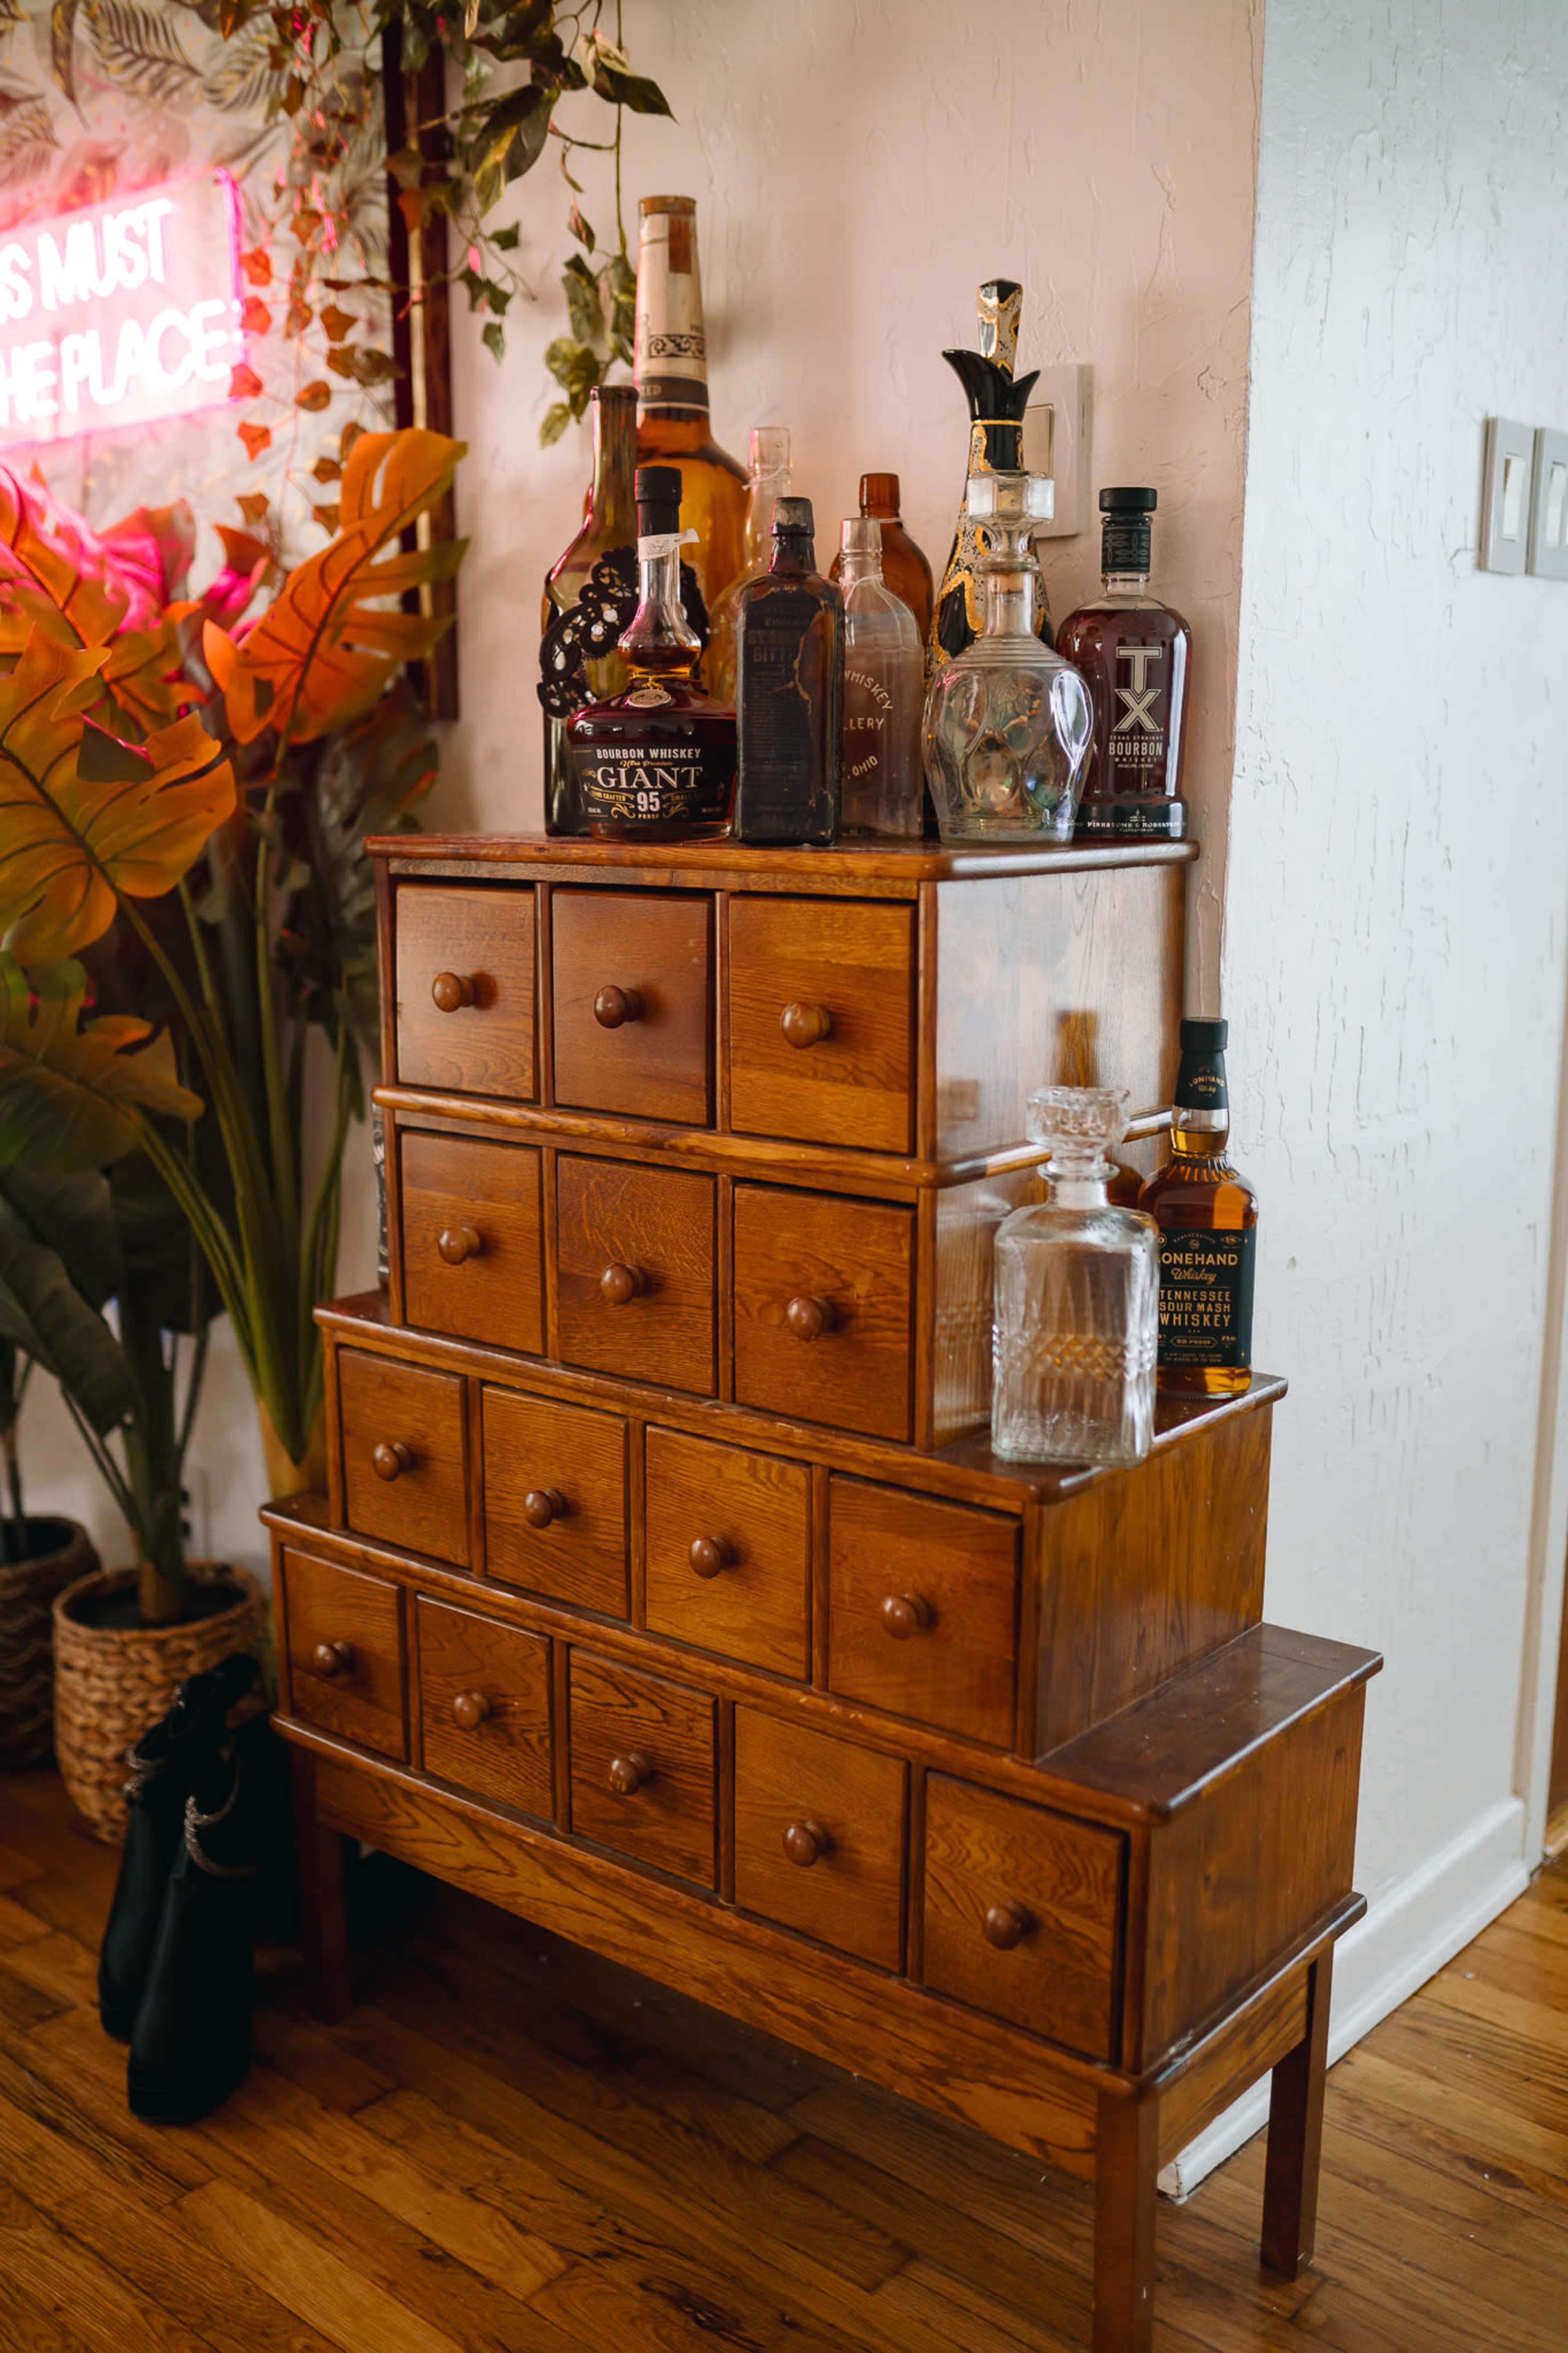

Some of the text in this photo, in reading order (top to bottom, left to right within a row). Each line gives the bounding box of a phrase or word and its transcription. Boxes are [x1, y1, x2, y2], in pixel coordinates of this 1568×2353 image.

[39, 199, 172, 310] MUST
[0, 300, 229, 424] HE PLACE
[1114, 646, 1163, 732] TX
[844, 717, 884, 730] LERY
[597, 748, 702, 759] BOURBON WHISKEY
[1109, 742, 1163, 755] BOURBON
[852, 755, 878, 776] OHIO
[597, 766, 703, 789] GIANT
[637, 791, 660, 812] 95
[1158, 1252, 1239, 1266] ONEHAND
[1171, 1267, 1217, 1286] Whiskey
[1160, 1290, 1231, 1301] TENNESSEE
[1160, 1302, 1231, 1313] SOUR MASH
[1160, 1313, 1231, 1327] WHISKEY
